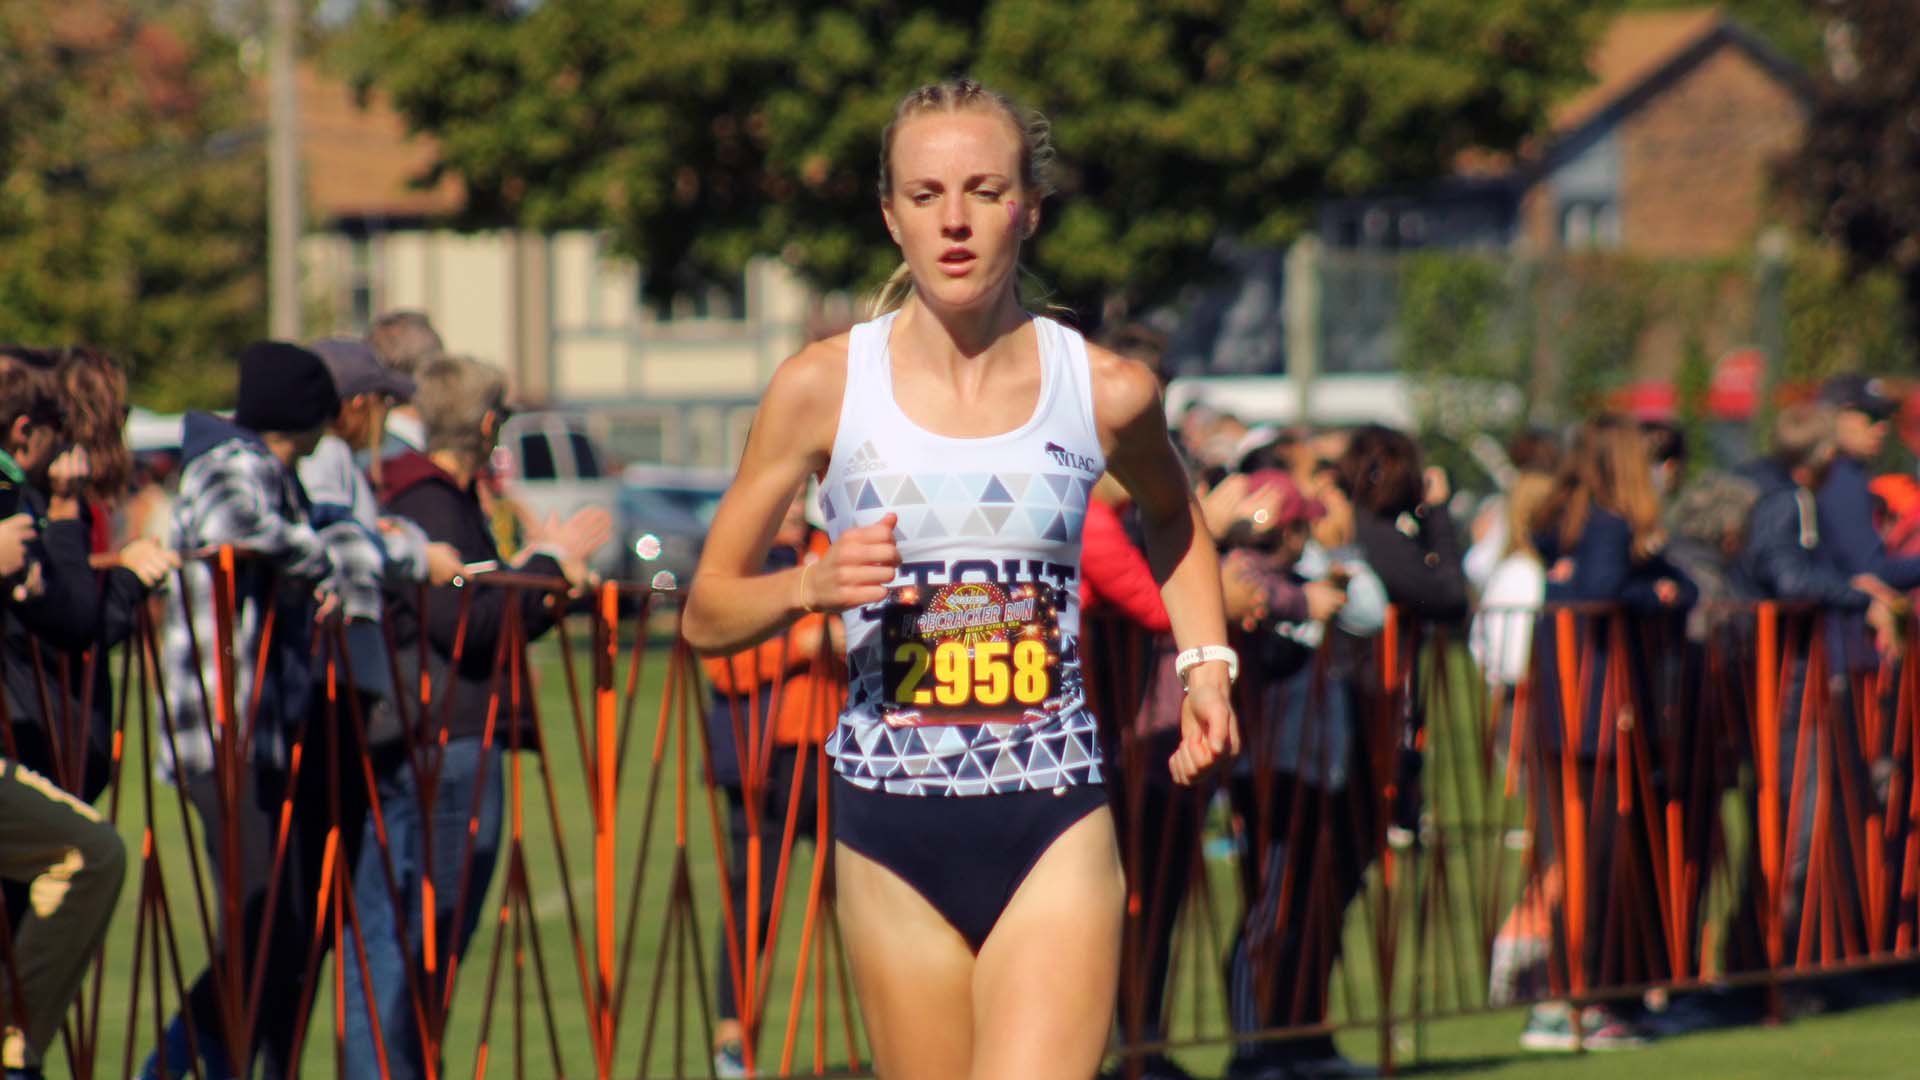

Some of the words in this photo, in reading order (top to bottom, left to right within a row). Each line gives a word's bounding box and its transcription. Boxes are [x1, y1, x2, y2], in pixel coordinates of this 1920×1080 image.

[844, 458, 888, 476] adidas
[1048, 451, 1095, 473] WIAC
[1004, 598, 1034, 621] RUN
[894, 640, 1048, 706] 2958
